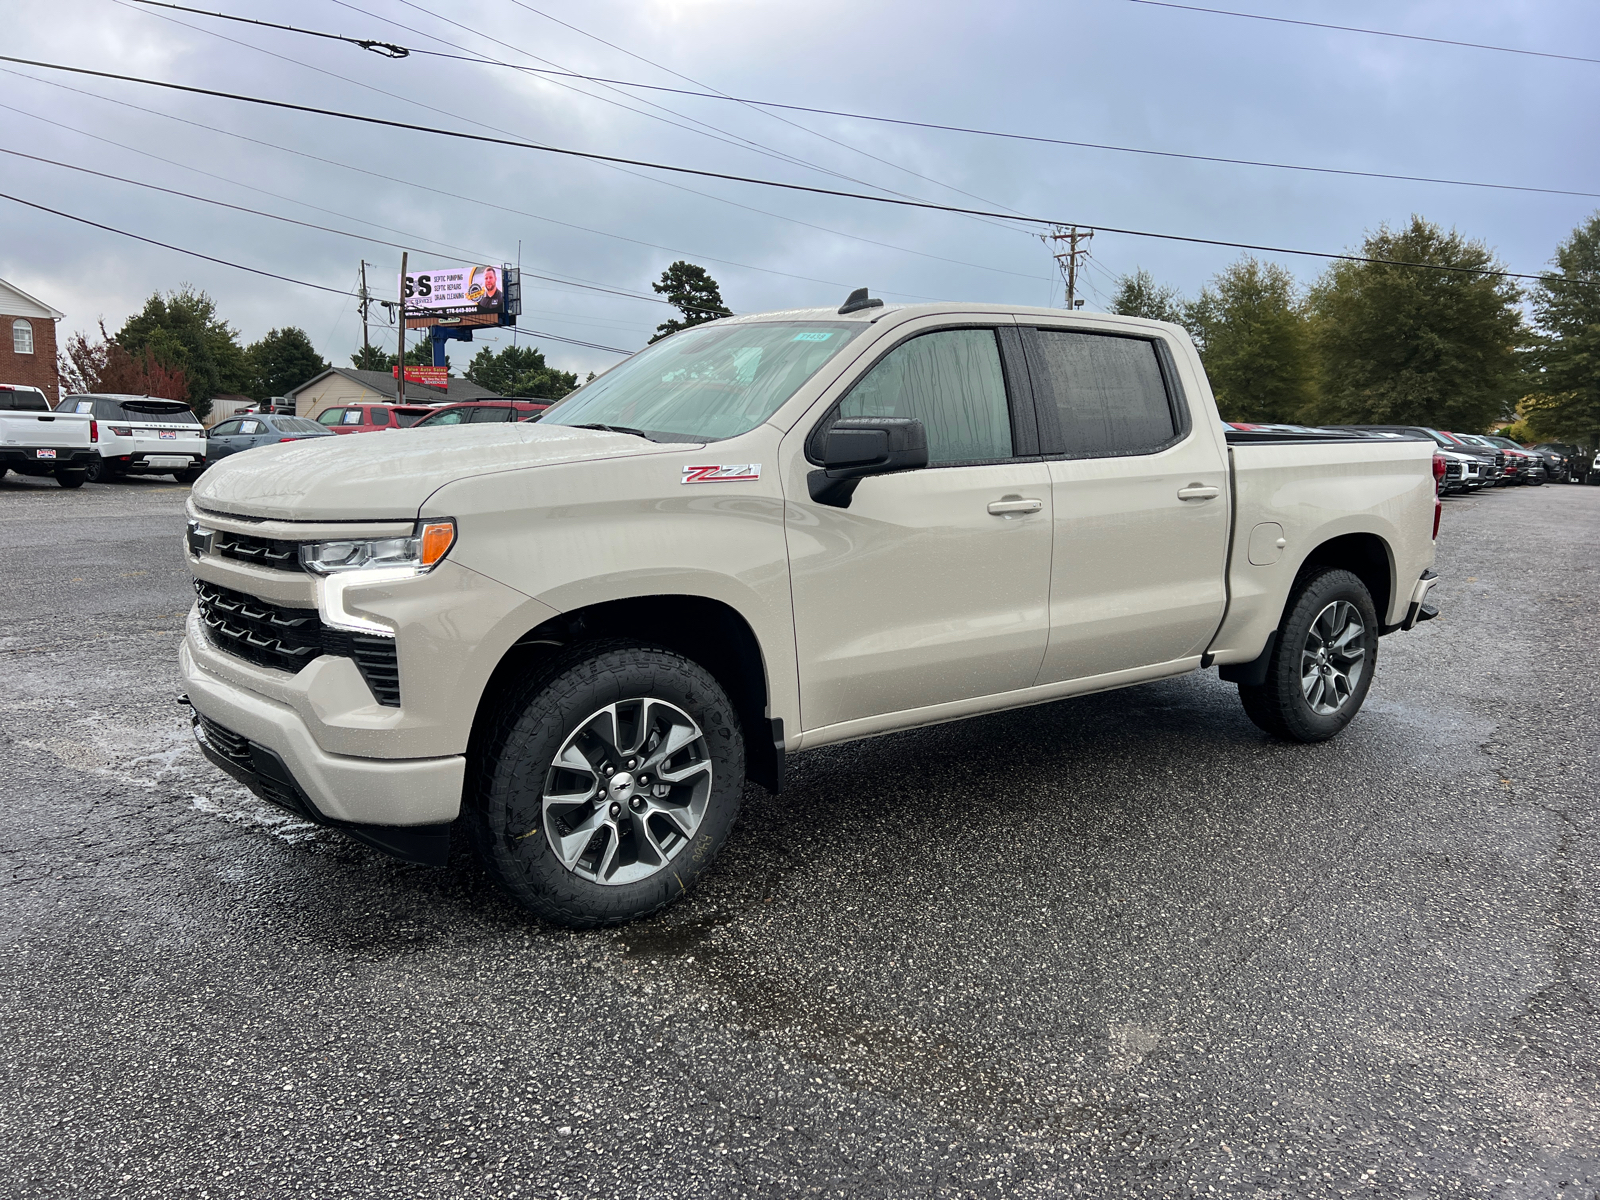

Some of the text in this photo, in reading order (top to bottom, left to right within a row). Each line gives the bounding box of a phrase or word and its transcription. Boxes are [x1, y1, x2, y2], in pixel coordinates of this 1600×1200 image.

[434, 283, 462, 292] SEPTIC REPAIRS
[446, 292, 465, 300] CLEANING
[681, 464, 762, 484] Z71
